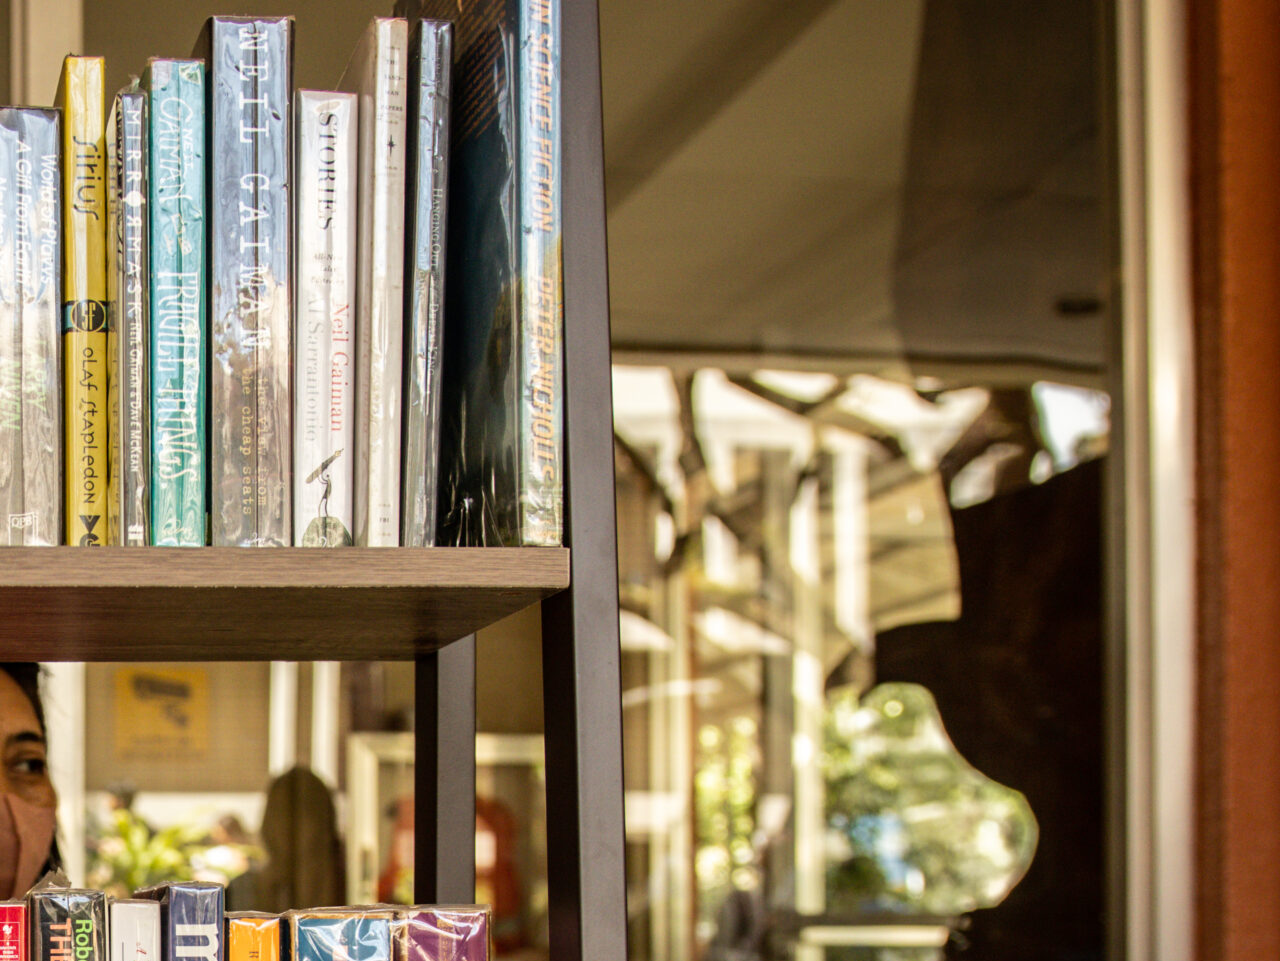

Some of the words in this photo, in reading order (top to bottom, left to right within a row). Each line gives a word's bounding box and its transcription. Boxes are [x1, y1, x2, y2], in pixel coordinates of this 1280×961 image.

[238, 28, 270, 143] NEIL
[319, 112, 337, 230] STORIES
[531, 138, 553, 232] FICTION
[239, 173, 271, 348] GAIMAN
[331, 303, 349, 343] Neil
[330, 351, 349, 432] Gaiman
